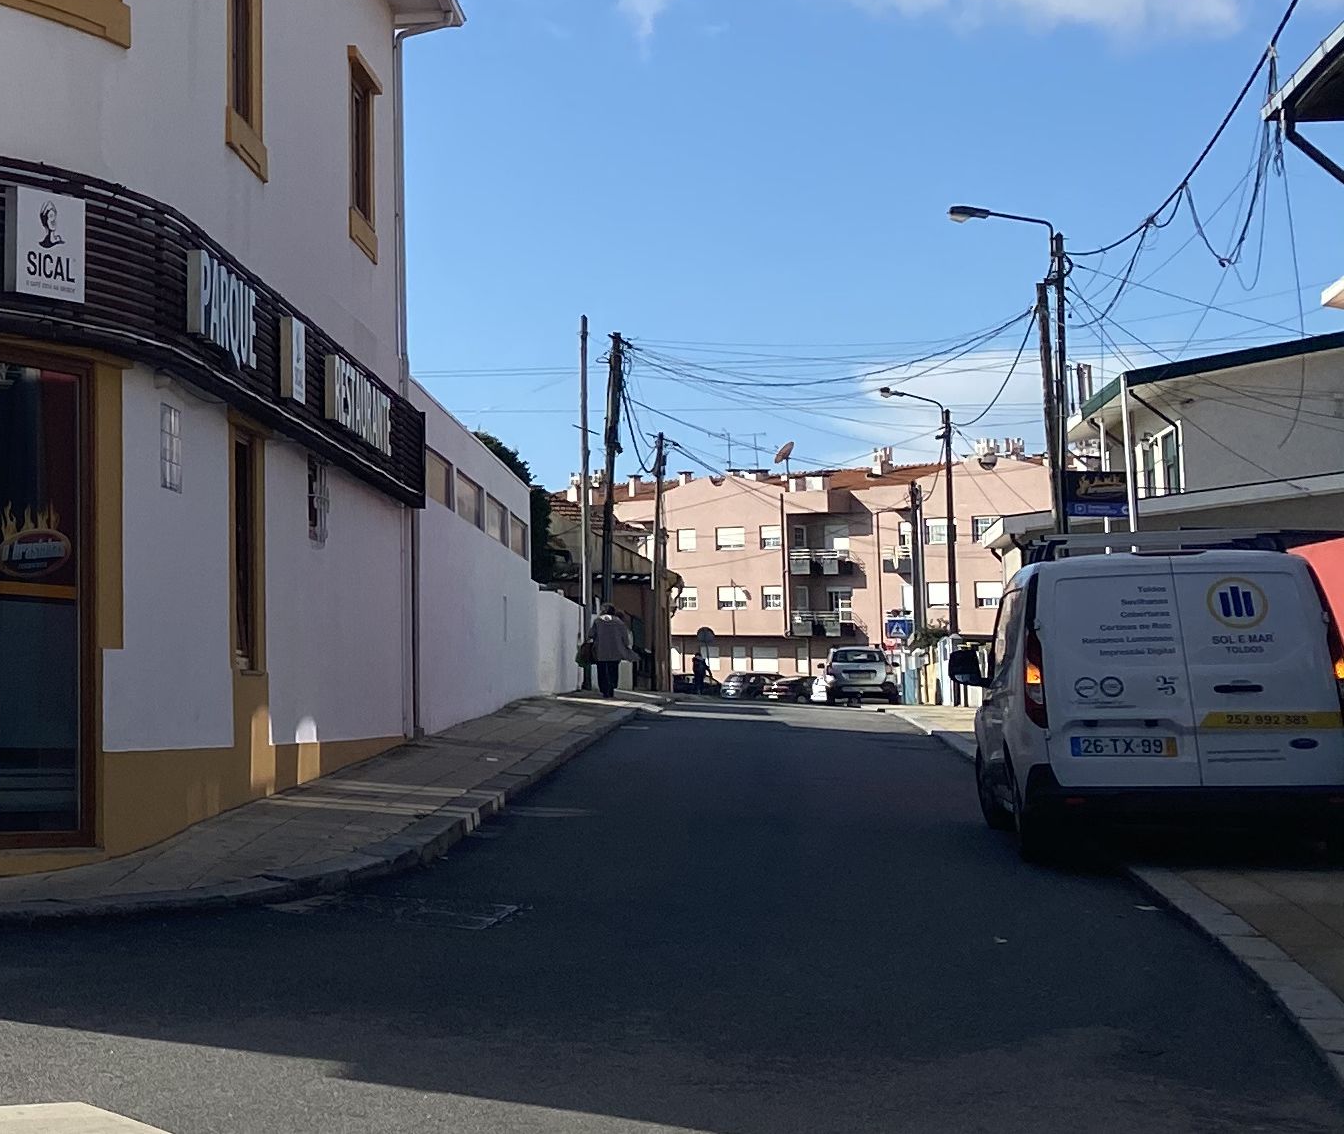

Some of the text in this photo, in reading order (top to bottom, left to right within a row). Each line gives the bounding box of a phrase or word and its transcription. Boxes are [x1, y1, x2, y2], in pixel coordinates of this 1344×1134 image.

[26, 250, 76, 284] SICAL
[200, 249, 257, 372] PARQUE
[334, 354, 392, 458] RESTAURANTE
[1212, 635, 1235, 645] SOL
[1248, 633, 1274, 643] MAR
